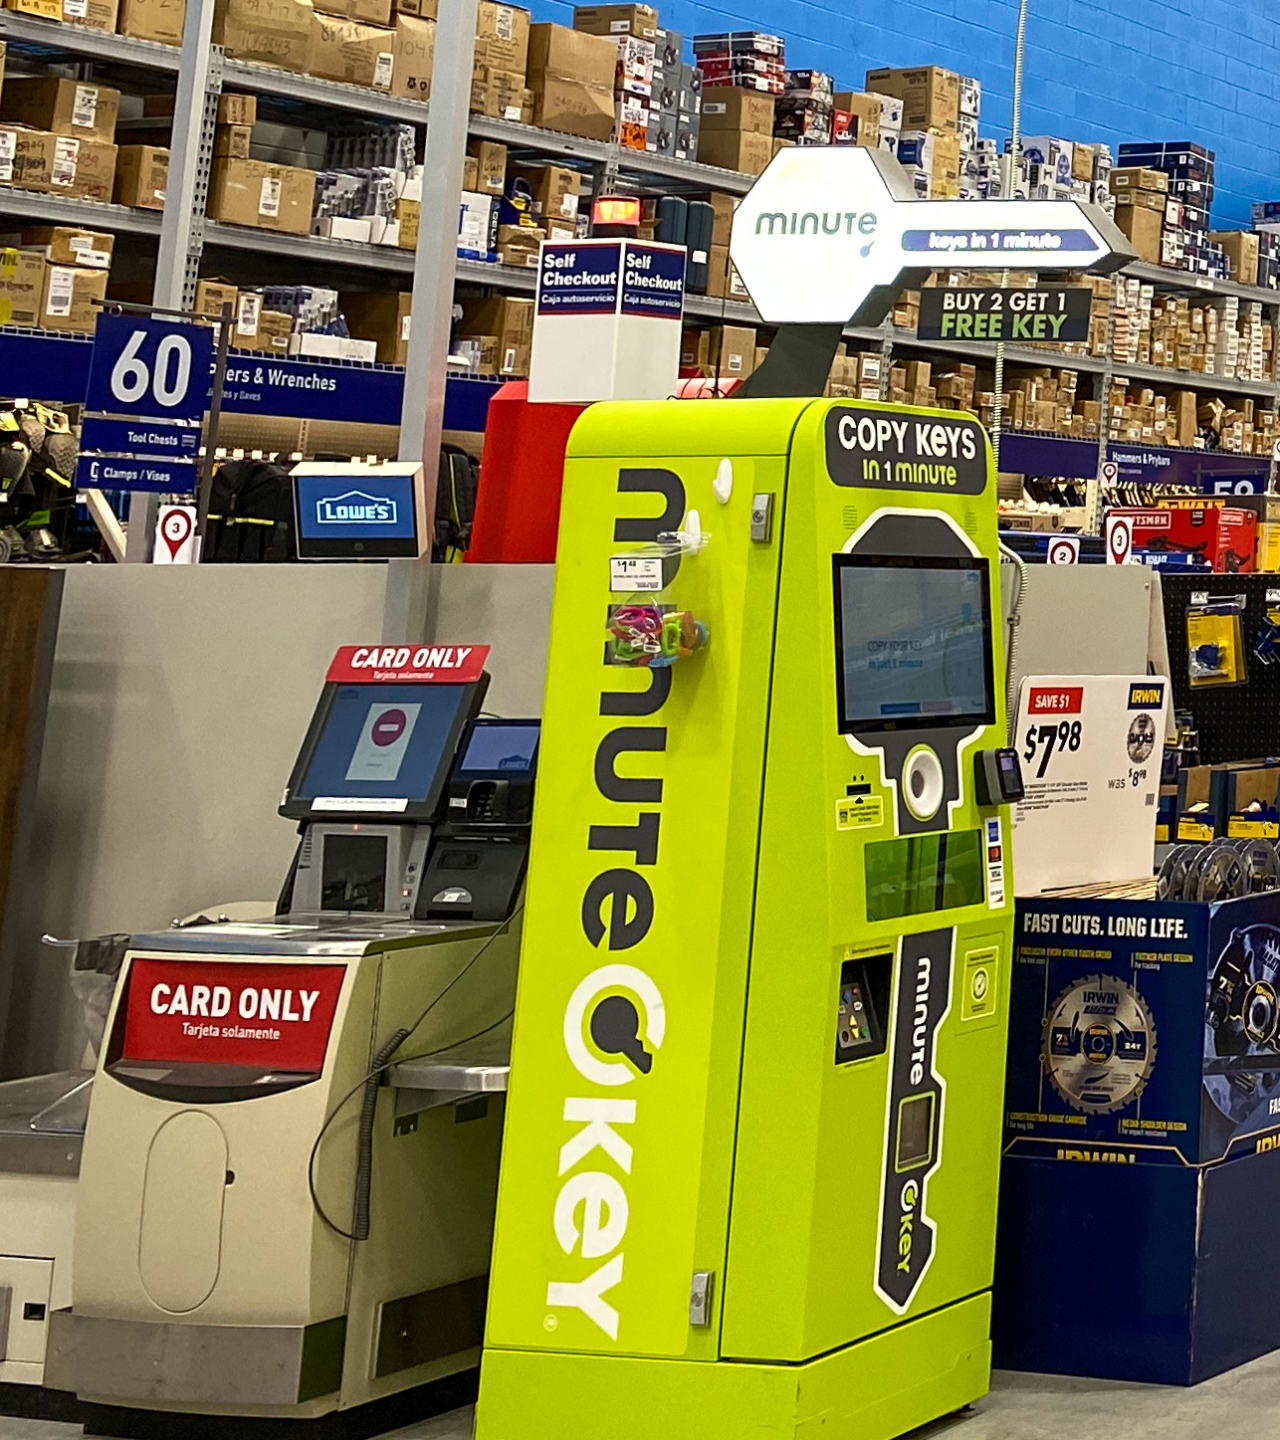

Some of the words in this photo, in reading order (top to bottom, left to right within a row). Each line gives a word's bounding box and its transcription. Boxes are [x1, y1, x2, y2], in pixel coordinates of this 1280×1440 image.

[755, 210, 877, 235] minute
[544, 254, 576, 269] Self
[626, 253, 651, 270] Self
[542, 271, 616, 287] Checkout
[625, 271, 682, 292] Checkout
[541, 294, 561, 304] Caja
[562, 293, 616, 304] autoservicio
[624, 294, 639, 305] Caja
[640, 297, 681, 309] autoservicio
[943, 293, 981, 310] BUY
[991, 294, 1002, 310] 2
[1010, 293, 1048, 310] GET
[1056, 293, 1066, 310] 1
[940, 313, 1002, 338] FREE
[1012, 314, 1068, 339] KEY
[110, 329, 192, 407] 60
[254, 367, 263, 384] &
[267, 369, 337, 392] Wrenches
[127, 431, 147, 445] Tool
[148, 433, 178, 447] Chests
[838, 414, 909, 454] COPY
[103, 466, 138, 483] Clamps
[146, 469, 171, 482] Vises
[884, 461, 892, 481] 1
[325, 503, 390, 520] LOWE'S
[351, 648, 409, 669] CARD
[412, 647, 471, 668] ONLY
[373, 670, 397, 680] Tarjeta
[398, 670, 434, 680] solamente
[1035, 694, 1059, 709] SAVE
[1059, 694, 1070, 710] $1
[1131, 688, 1161, 704] IRWIN
[1024, 913, 1059, 933] FAST
[1062, 914, 1104, 936] CUTS.
[1107, 916, 1147, 938] LONG
[1150, 917, 1189, 939] LIFE.
[150, 983, 232, 1018] CARD
[238, 986, 320, 1023] ONLY
[1082, 990, 1120, 1006] IRWIN
[909, 957, 931, 1086] minute
[182, 1022, 220, 1041] Tarjeta
[222, 1024, 281, 1041] solamente
